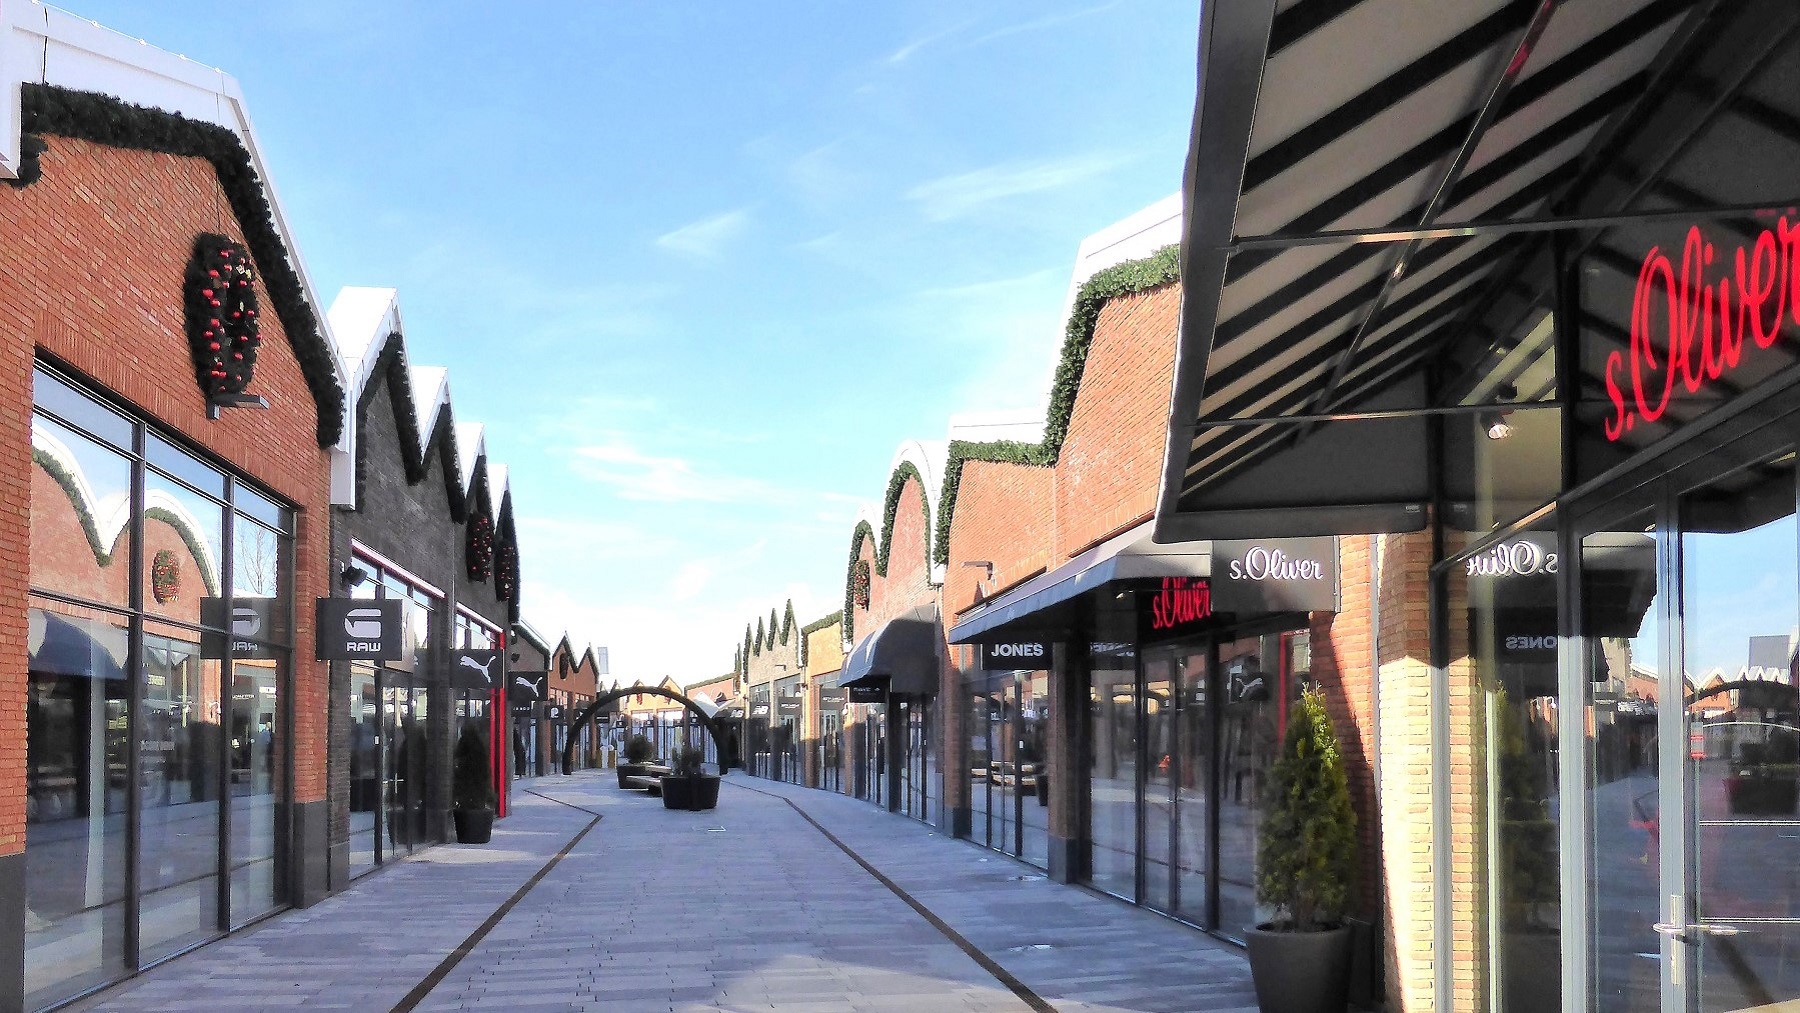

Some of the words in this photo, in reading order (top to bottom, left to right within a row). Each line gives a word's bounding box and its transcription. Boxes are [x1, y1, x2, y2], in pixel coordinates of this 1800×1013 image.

[1229, 546, 1324, 581] s.Oliver
[1153, 577, 1211, 630] s.Oliver
[346, 642, 381, 652] RAW
[991, 643, 1044, 657] JONES
